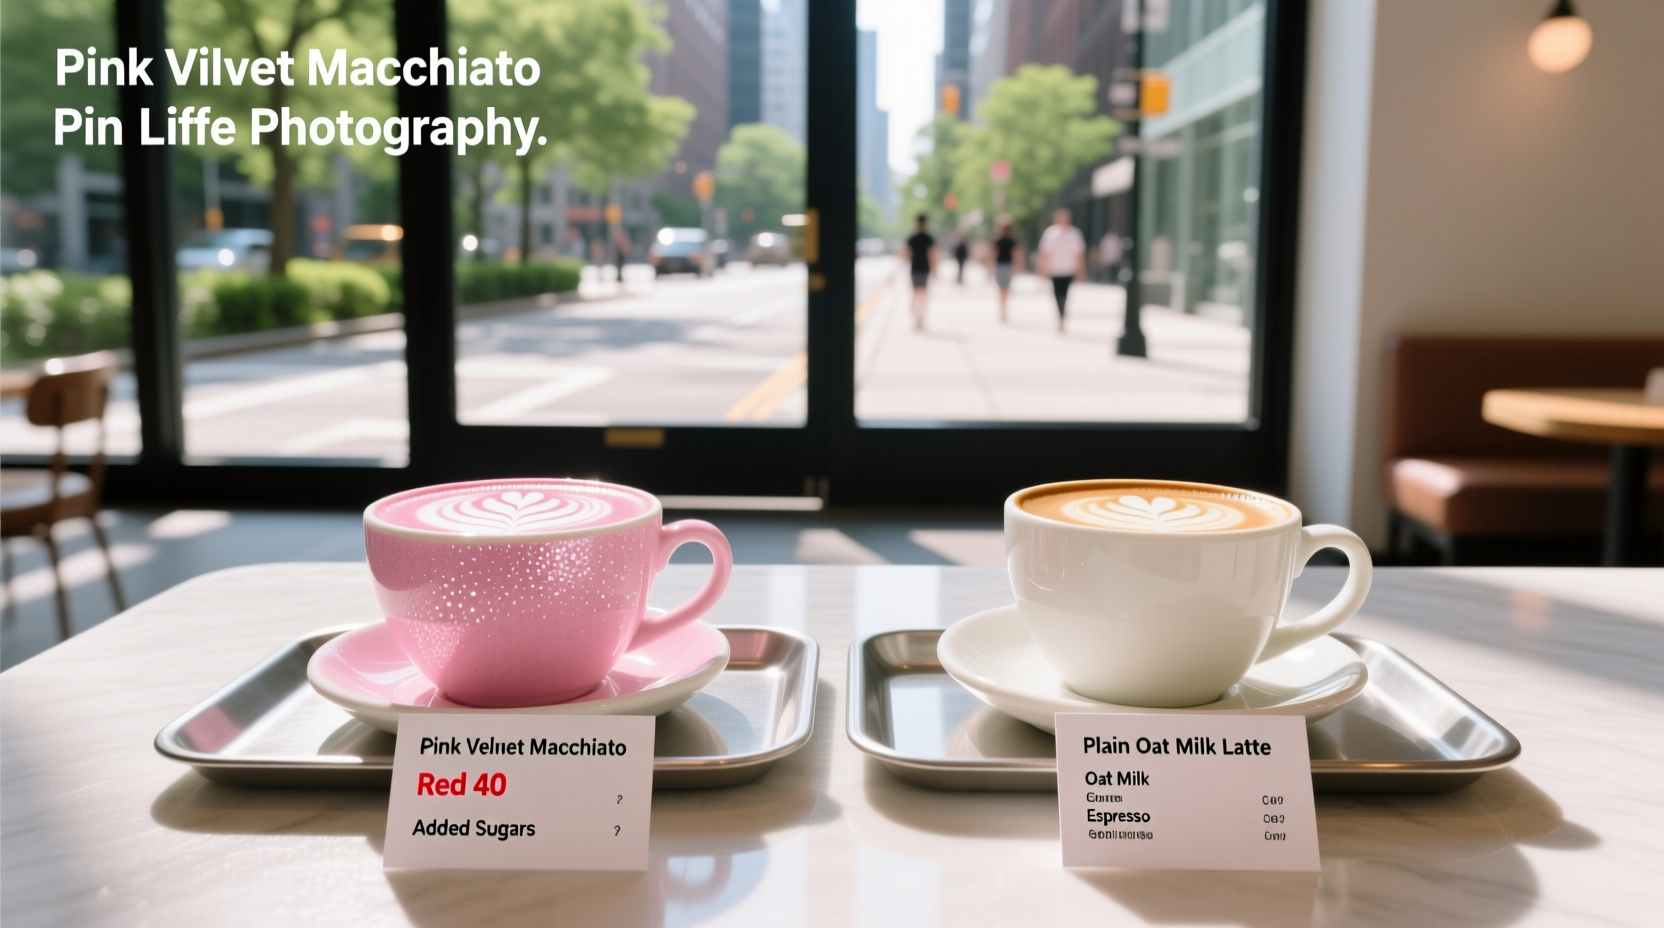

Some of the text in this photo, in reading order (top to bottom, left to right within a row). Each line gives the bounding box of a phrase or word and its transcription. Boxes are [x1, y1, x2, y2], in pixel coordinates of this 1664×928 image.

[419, 735, 462, 755] Pink
[529, 737, 628, 757] Macchiato
[1083, 735, 1272, 756] Plain Oat Milk Latte
[416, 771, 507, 797] Red 40
[1084, 770, 1150, 787] Oat Milk
[1086, 808, 1151, 827] Espresso
[411, 818, 471, 837] Added
[475, 818, 536, 842] Sugars
